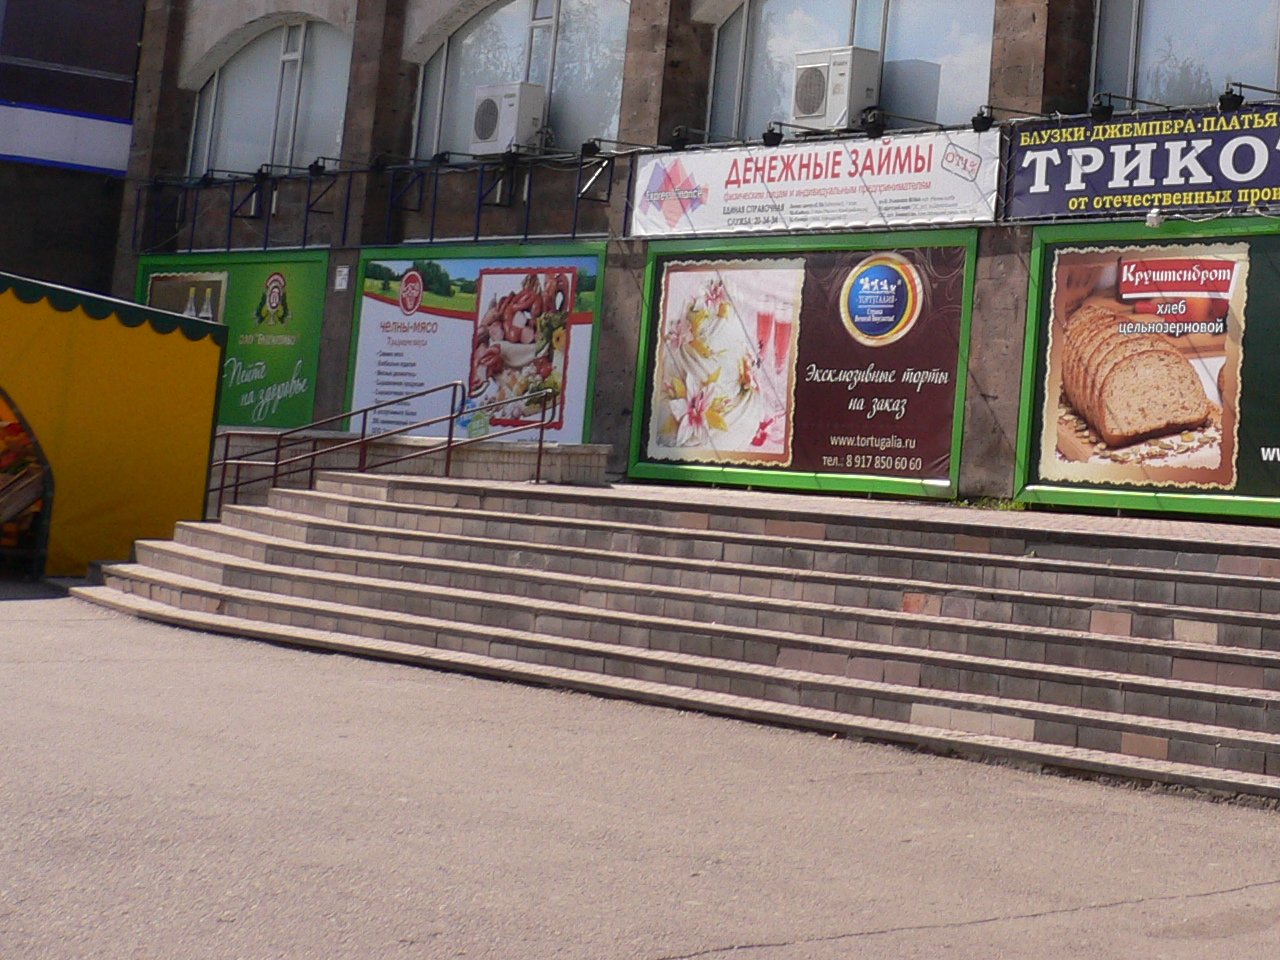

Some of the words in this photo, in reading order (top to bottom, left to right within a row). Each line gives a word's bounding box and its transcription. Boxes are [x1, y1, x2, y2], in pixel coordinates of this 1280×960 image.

[1020, 127, 1085, 147] БЛУЗКИ
[1091, 118, 1195, 142] ДЖЕМПЕРА
[1201, 111, 1278, 134] ПЛАТЬЯ
[724, 150, 842, 189] ДЕНЕЖНЫЕ
[849, 139, 934, 178] ЗАЙМЫ
[1068, 195, 1088, 211] от
[1093, 188, 1233, 210] отечественных
[1156, 300, 1186, 315] хлеб
[1118, 318, 1224, 337] цельнозерновой
[805, 363, 896, 390] Эксклюзивные
[901, 367, 950, 392] торты
[848, 397, 865, 411] на
[867, 397, 908, 419] заказ
[830, 433, 916, 451] www.tortugalia.ru
[846, 455, 853, 467] 8
[854, 455, 873, 468] 917
[874, 456, 893, 469] 850
[894, 457, 908, 470] 60
[909, 457, 922, 470] 60
